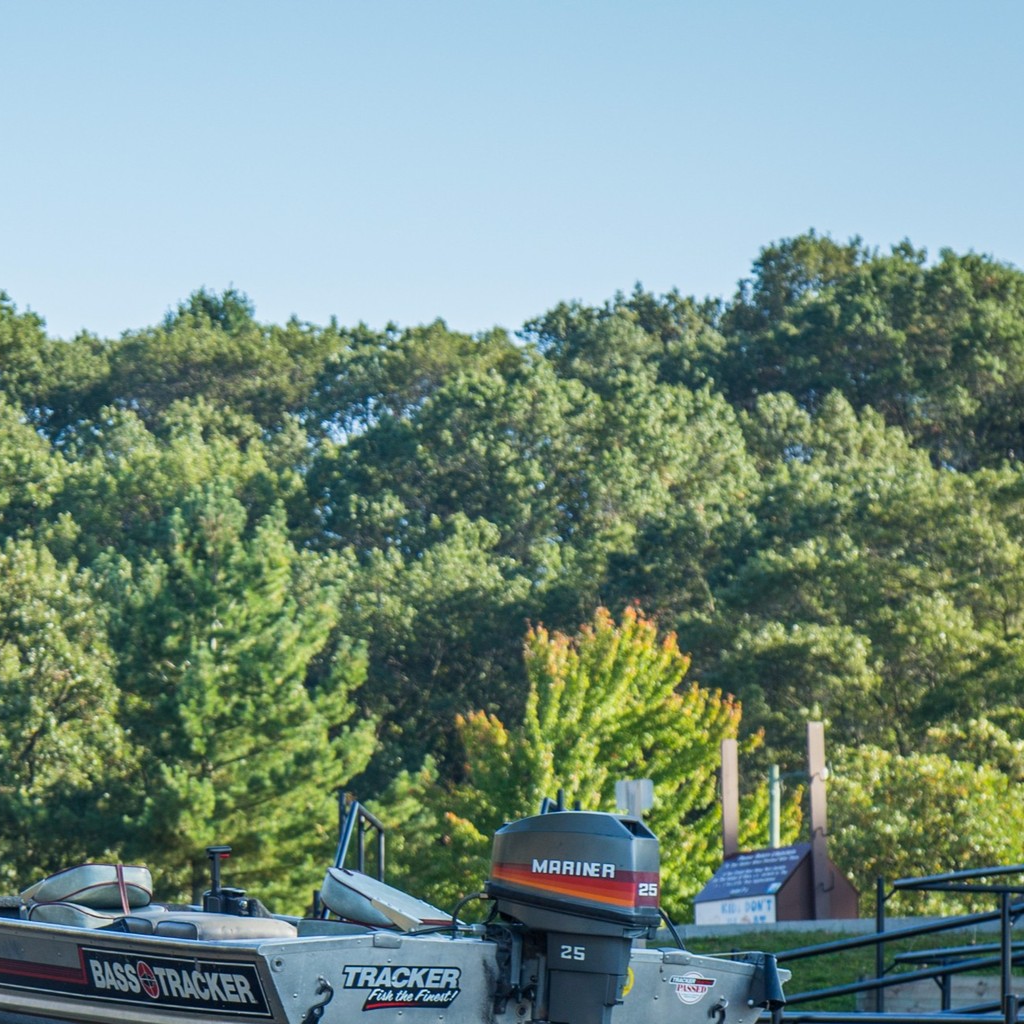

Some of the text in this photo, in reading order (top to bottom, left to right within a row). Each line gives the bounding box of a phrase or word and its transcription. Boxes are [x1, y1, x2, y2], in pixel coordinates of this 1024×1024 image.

[531, 859, 616, 878] MARINER
[638, 883, 658, 896] 25
[560, 945, 586, 961] 25
[89, 959, 259, 1004] BASS TRACKER
[343, 966, 461, 989] TRACKER
[368, 988, 459, 1002] Fish the Finest!
[677, 984, 707, 993] PASSED
